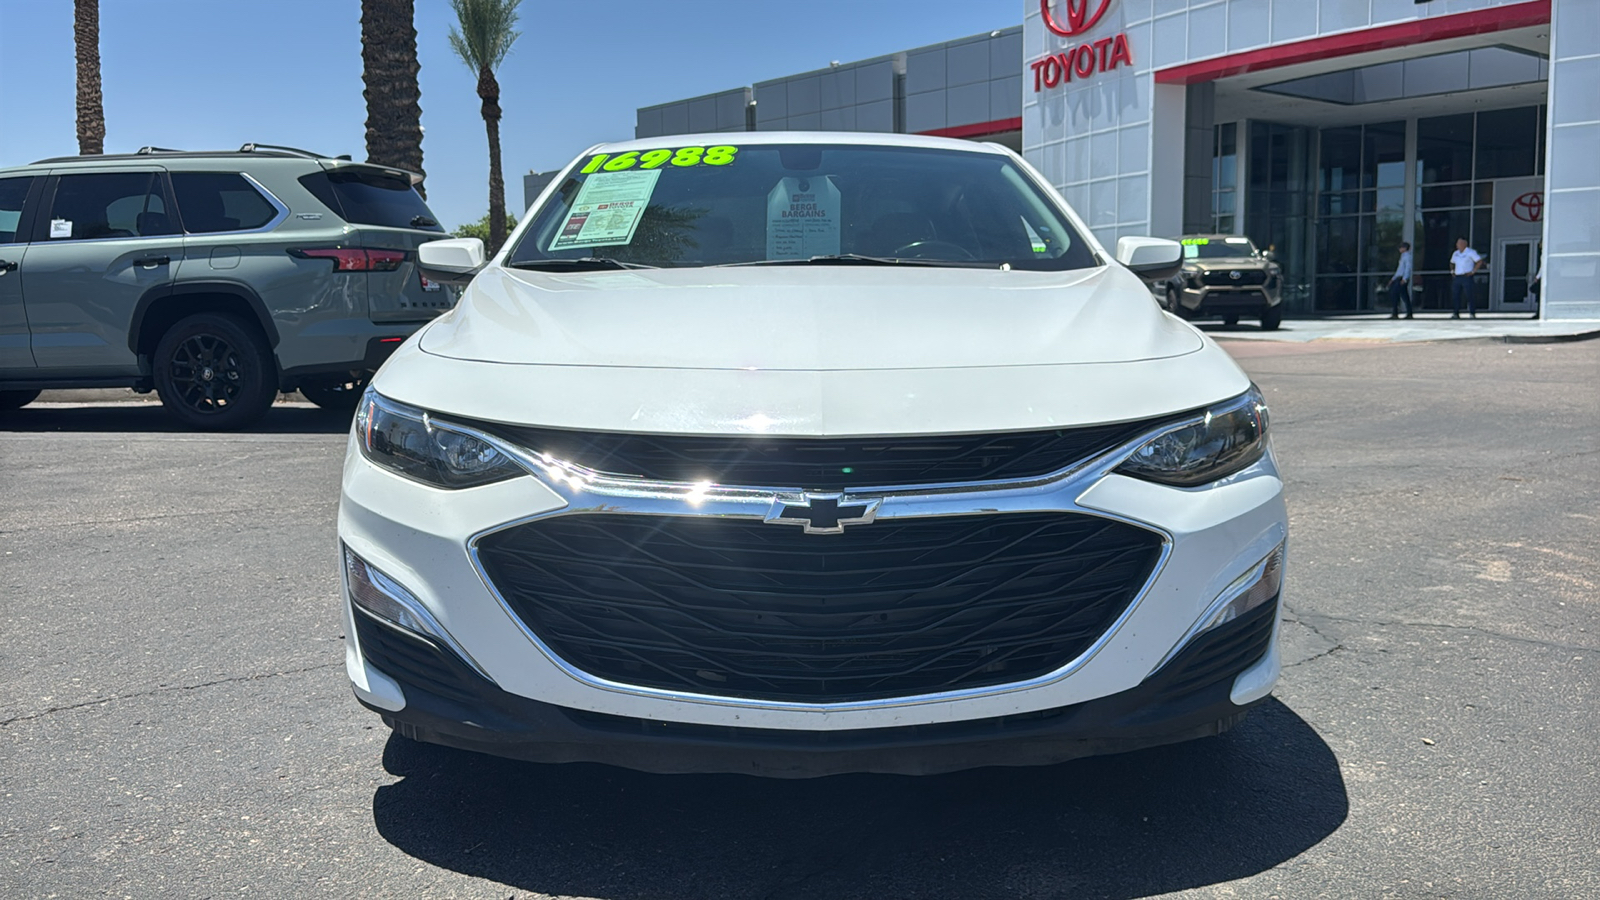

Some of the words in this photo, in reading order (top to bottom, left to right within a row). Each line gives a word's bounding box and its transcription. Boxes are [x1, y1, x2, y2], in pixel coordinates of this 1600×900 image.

[1030, 32, 1133, 93] TOYOTA
[580, 145, 738, 173] 16988
[781, 210, 826, 218] BARGAINS
[790, 203, 818, 211] BERGE
